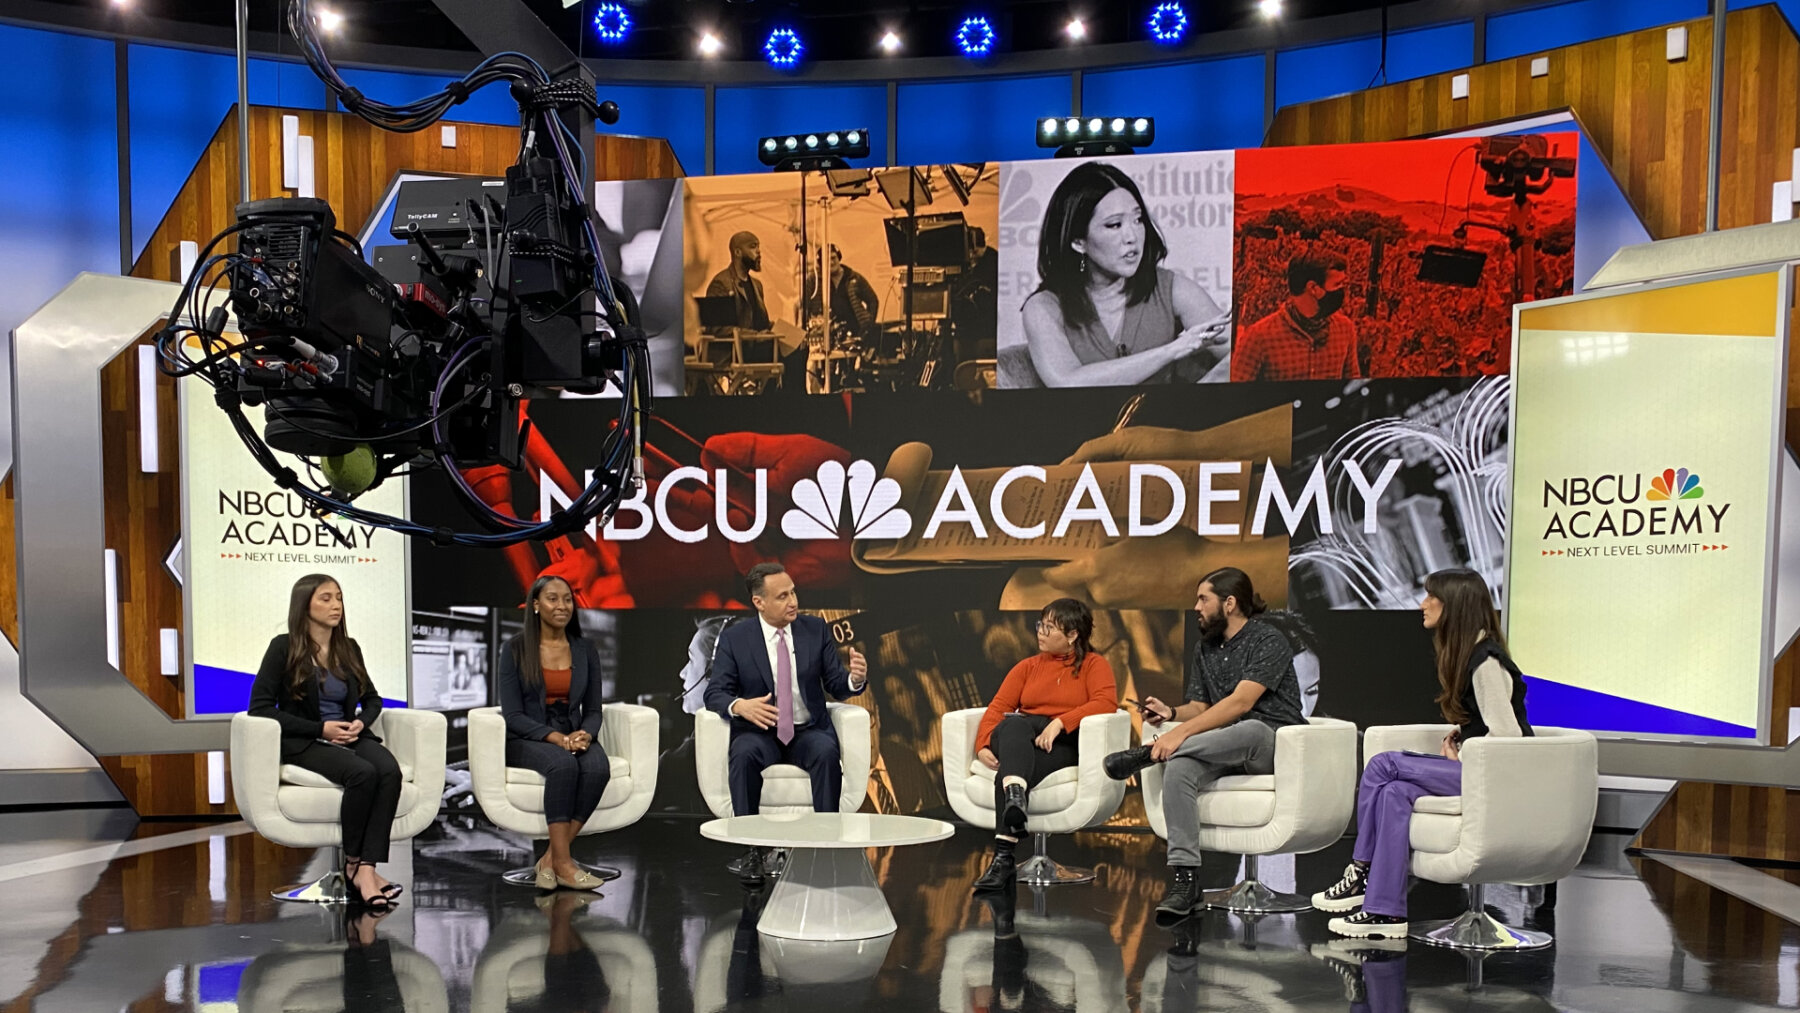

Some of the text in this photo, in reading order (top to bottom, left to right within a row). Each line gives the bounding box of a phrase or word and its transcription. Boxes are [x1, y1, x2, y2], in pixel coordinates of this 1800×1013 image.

[219, 489, 306, 518] NBCU
[540, 466, 767, 543] NBCU
[922, 457, 1403, 539] ACADEMY
[1543, 473, 1641, 508] NBCU
[221, 519, 377, 549] ACADEMY
[1543, 503, 1731, 540] ACADEMY
[244, 552, 356, 564] NEXT LEVEL SUMMIT
[1567, 544, 1700, 557] NEXT LEVEL SUMMIT
[833, 620, 854, 643] 03
